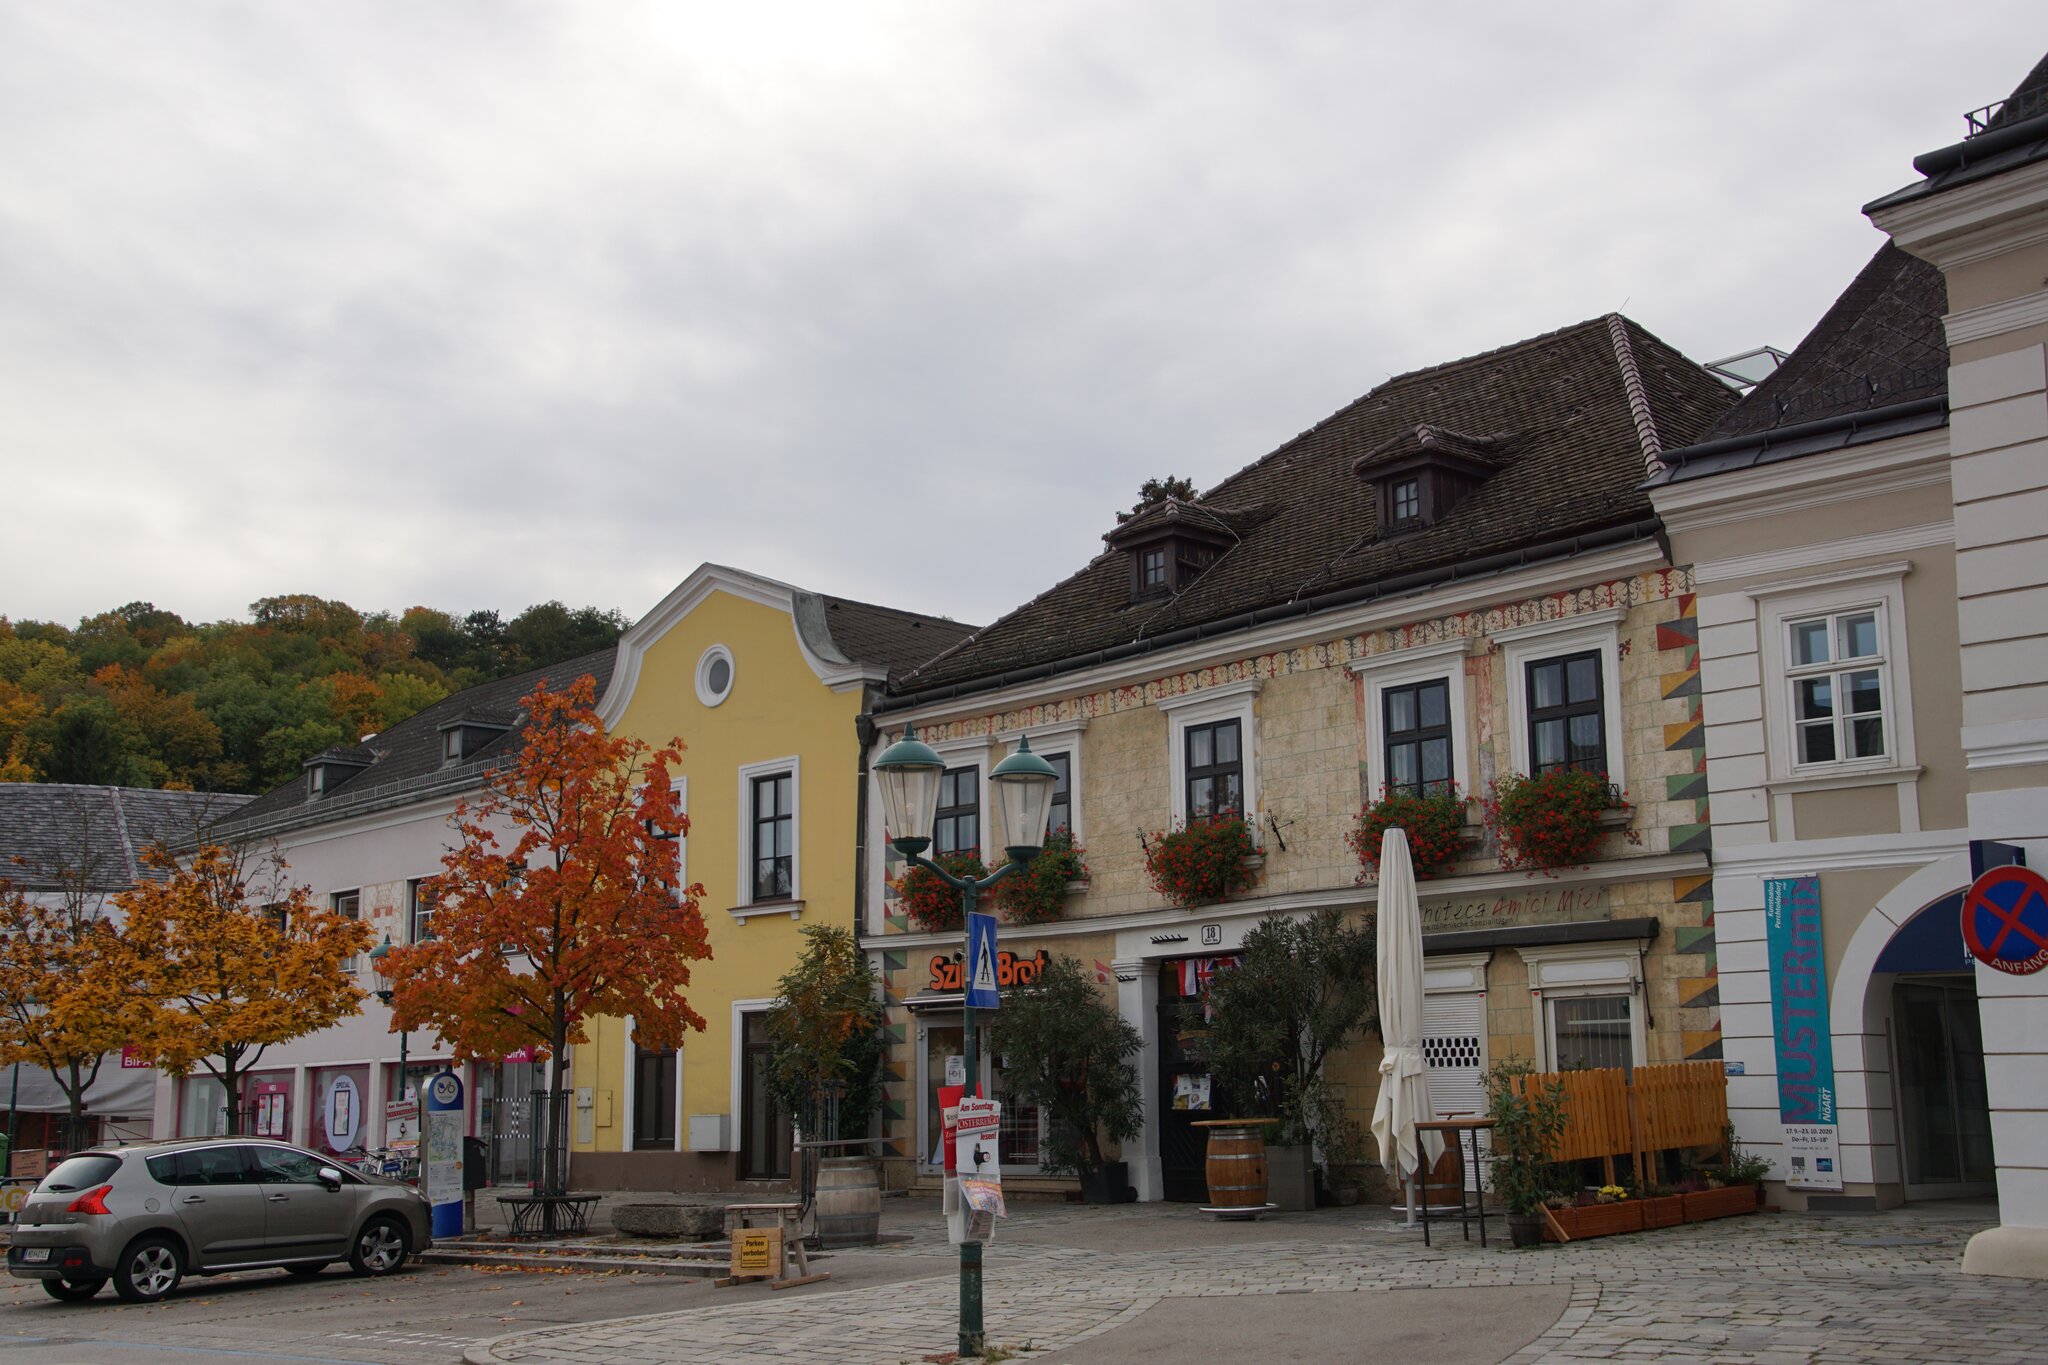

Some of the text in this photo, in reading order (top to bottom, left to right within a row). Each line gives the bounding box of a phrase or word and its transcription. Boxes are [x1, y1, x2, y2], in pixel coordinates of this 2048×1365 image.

[1419, 888, 1602, 923] noteca Amici Miei
[1774, 881, 1782, 928] Perchtoldsdorf
[1206, 926, 1216, 939] 18
[997, 949, 1047, 987] Brot
[1991, 948, 2048, 973] ANFANG
[960, 1102, 994, 1112] Am Sonntag
